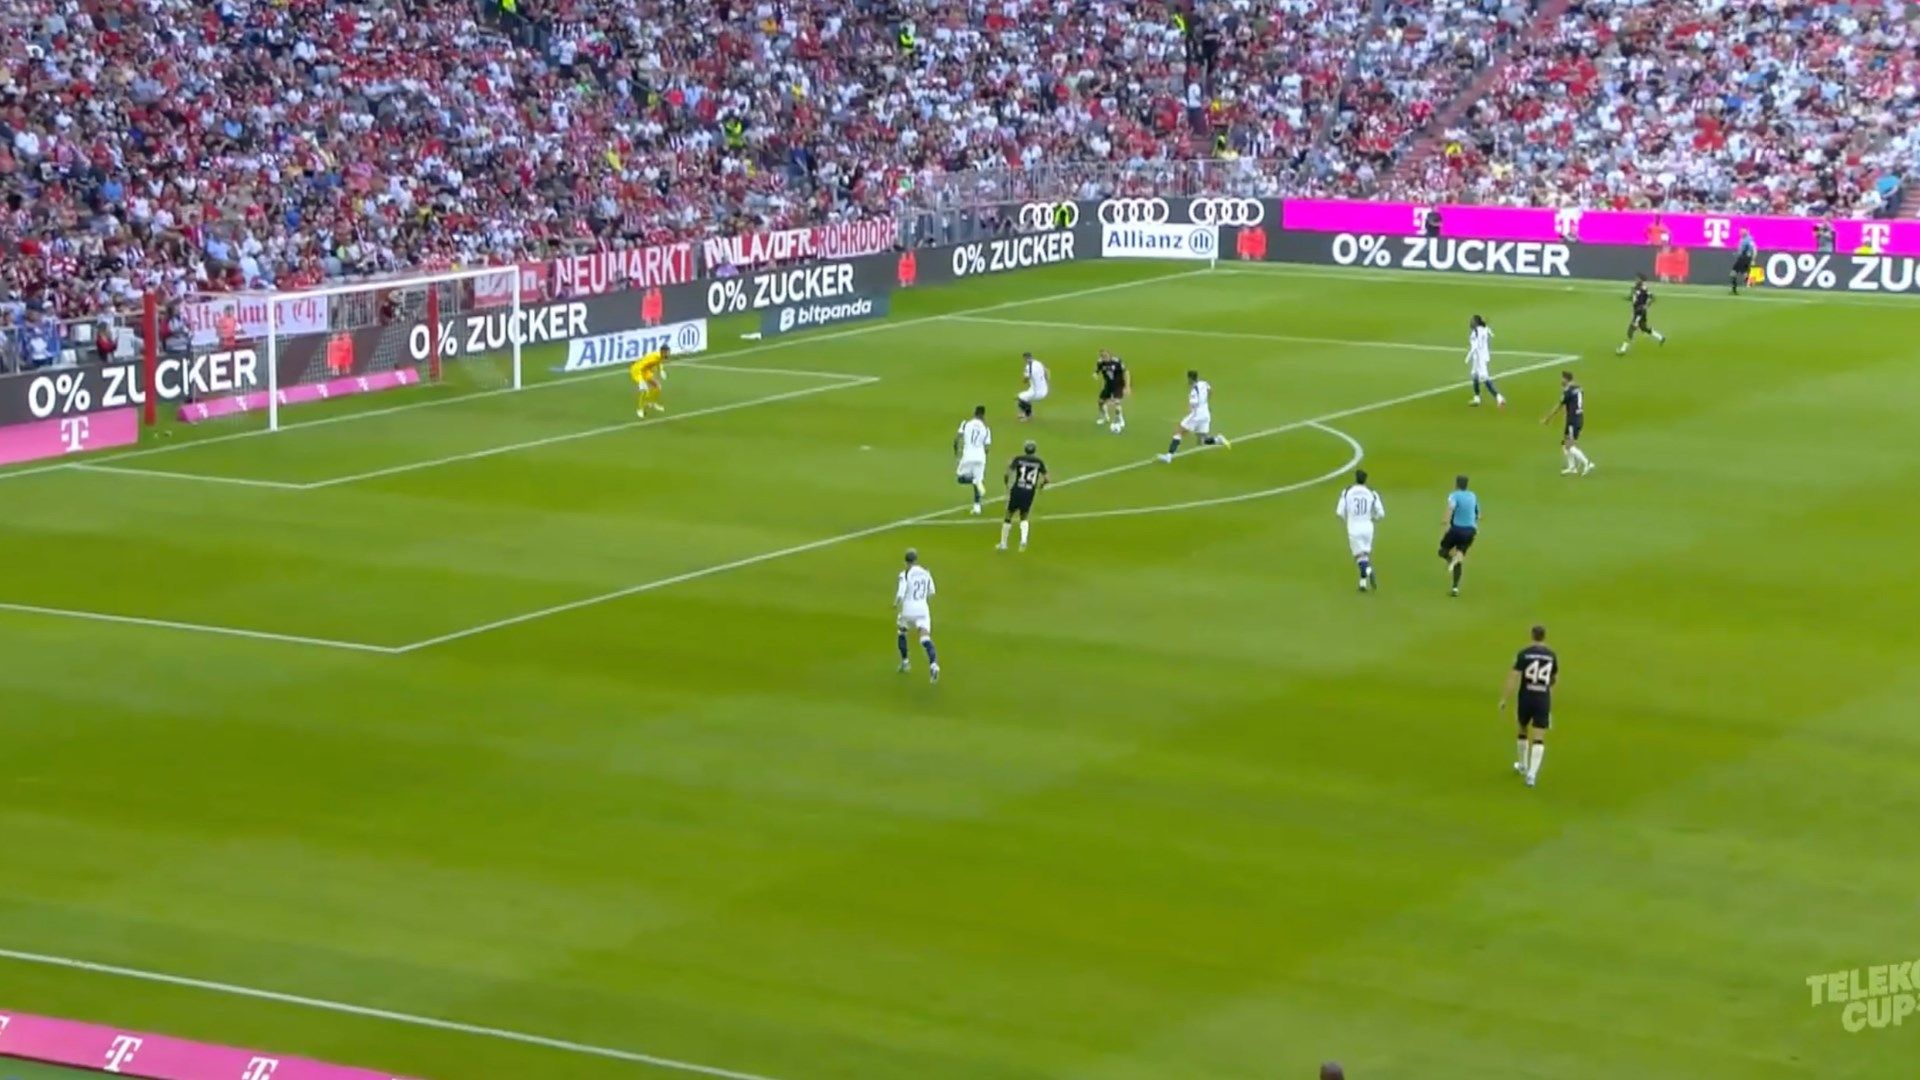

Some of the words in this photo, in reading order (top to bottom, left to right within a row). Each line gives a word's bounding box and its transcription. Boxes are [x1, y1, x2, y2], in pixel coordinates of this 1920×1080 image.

[952, 242, 985, 276] 0%
[990, 231, 1074, 271] ZUCKER
[1107, 231, 1182, 249] Allianz
[1332, 233, 1391, 267] 0%
[1402, 237, 1570, 276] ZUCKER
[555, 242, 690, 297] NEUMARKT
[1766, 253, 1836, 287] 0%
[1849, 256, 1920, 292] ZU
[707, 278, 747, 314] 0%
[754, 263, 854, 308] ZUCKER
[798, 299, 872, 324] bitpanda
[409, 320, 458, 360] 0%
[466, 302, 588, 352] ZUCKER
[577, 334, 672, 366] Allianz
[28, 372, 91, 418] 0%
[102, 350, 257, 407] ZUCKER
[61, 416, 89, 452] T
[1019, 465, 1039, 487] 14
[1354, 497, 1367, 516] 30
[1525, 660, 1553, 685] 44
